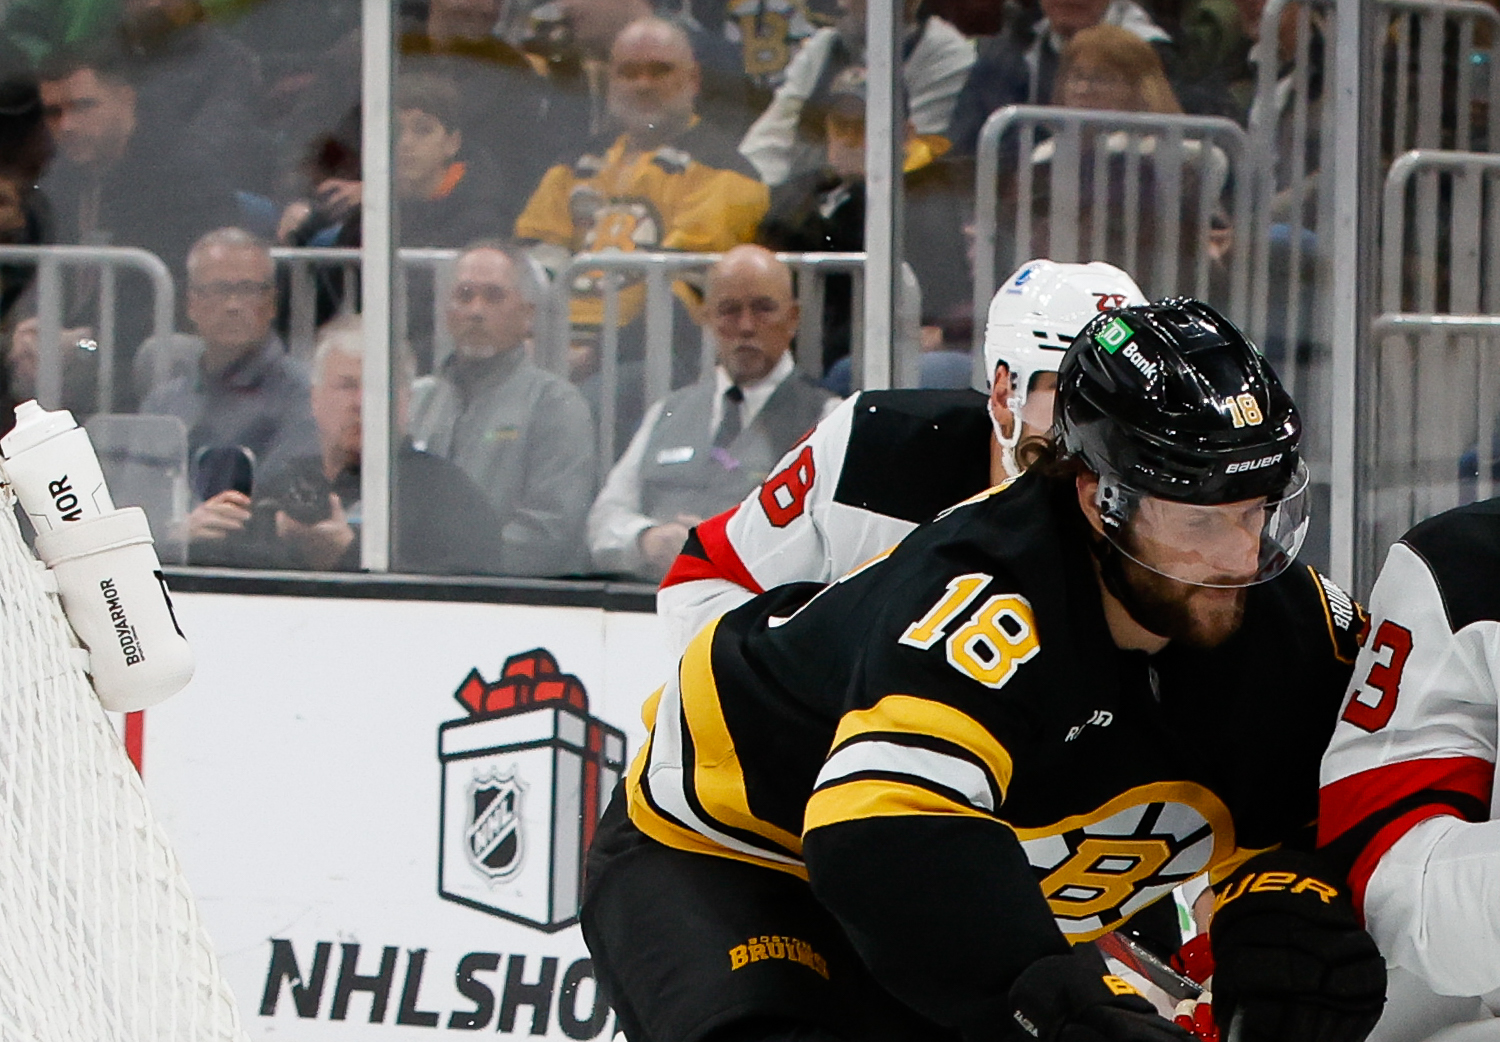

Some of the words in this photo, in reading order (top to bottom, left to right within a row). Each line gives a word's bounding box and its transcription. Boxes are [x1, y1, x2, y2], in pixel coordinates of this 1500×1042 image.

[1122, 340, 1158, 380] Bank
[1226, 393, 1264, 429] 18
[1225, 454, 1284, 476] BAUER
[100, 577, 141, 667] BODYARMOR
[897, 572, 1041, 690] 18
[471, 797, 515, 859] NHL
